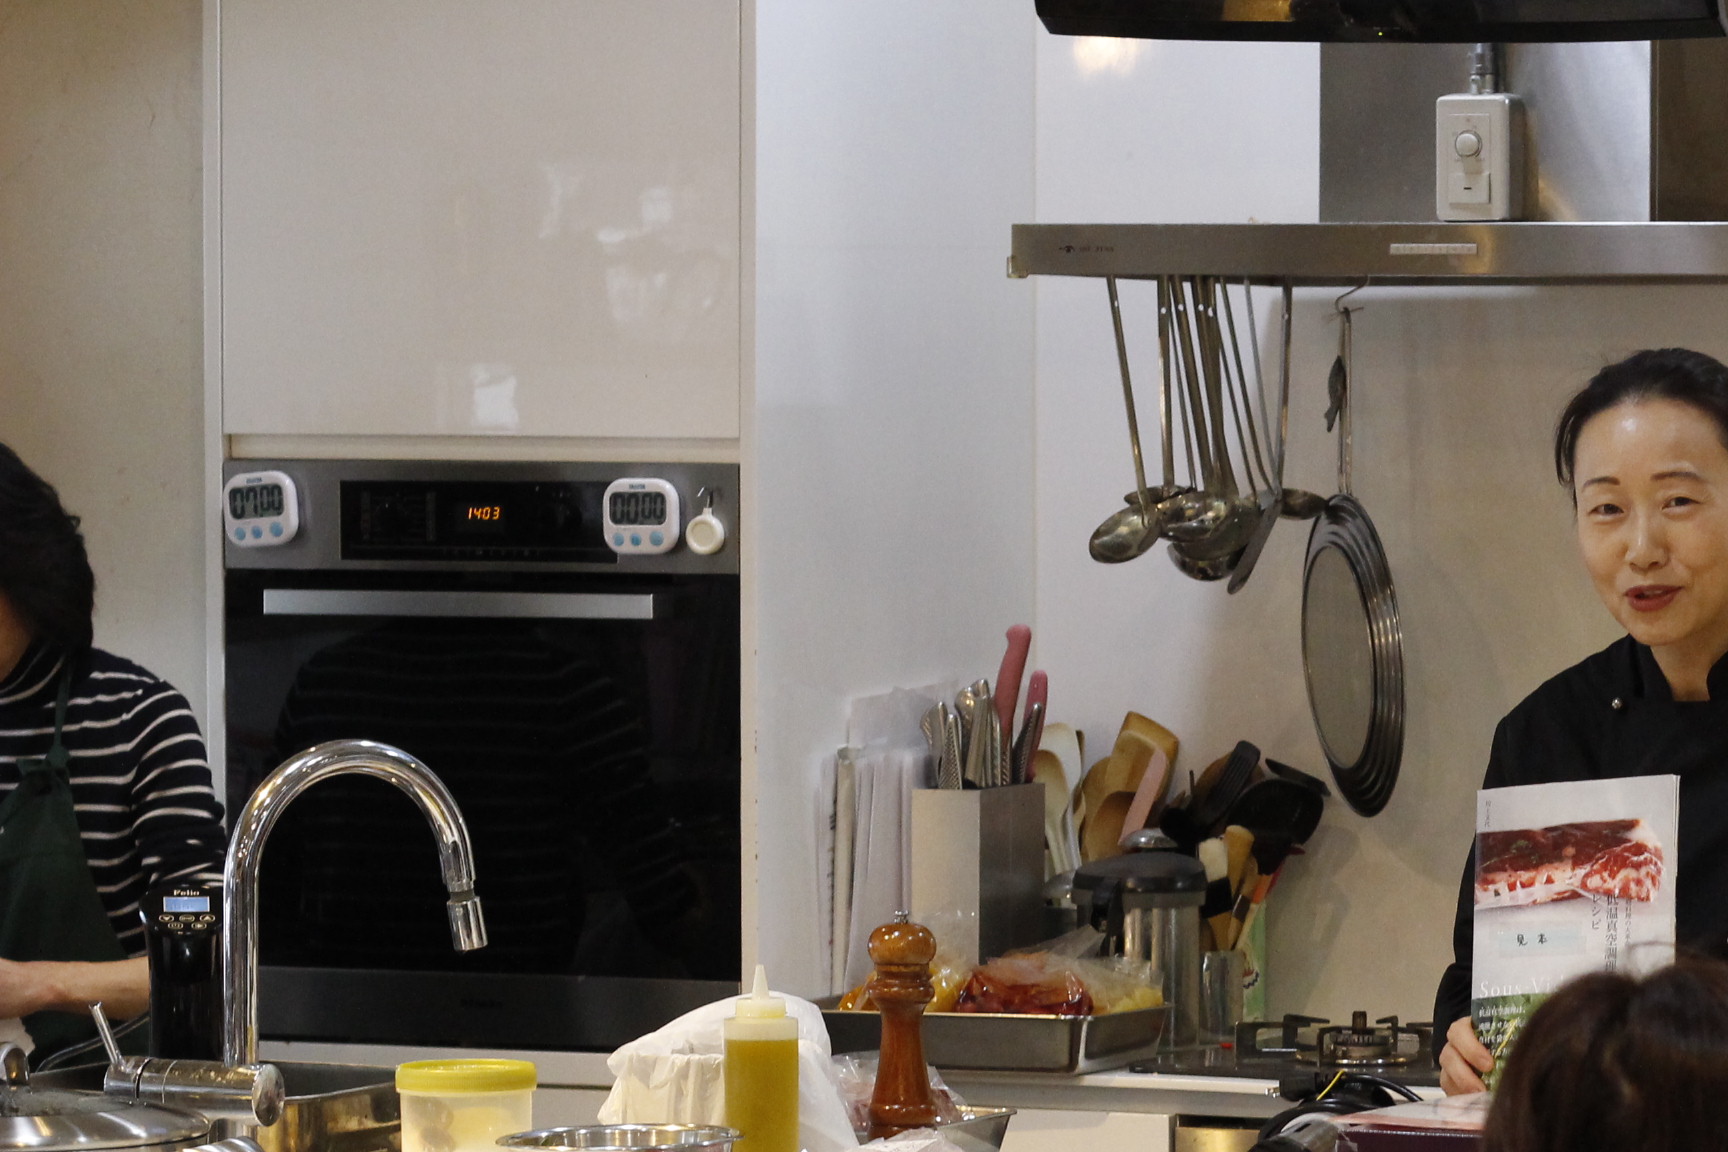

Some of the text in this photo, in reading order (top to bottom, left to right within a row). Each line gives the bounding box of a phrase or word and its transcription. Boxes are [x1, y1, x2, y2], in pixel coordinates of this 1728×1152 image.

[467, 506, 501, 521] 1403
[1592, 894, 1601, 930] レシピ
